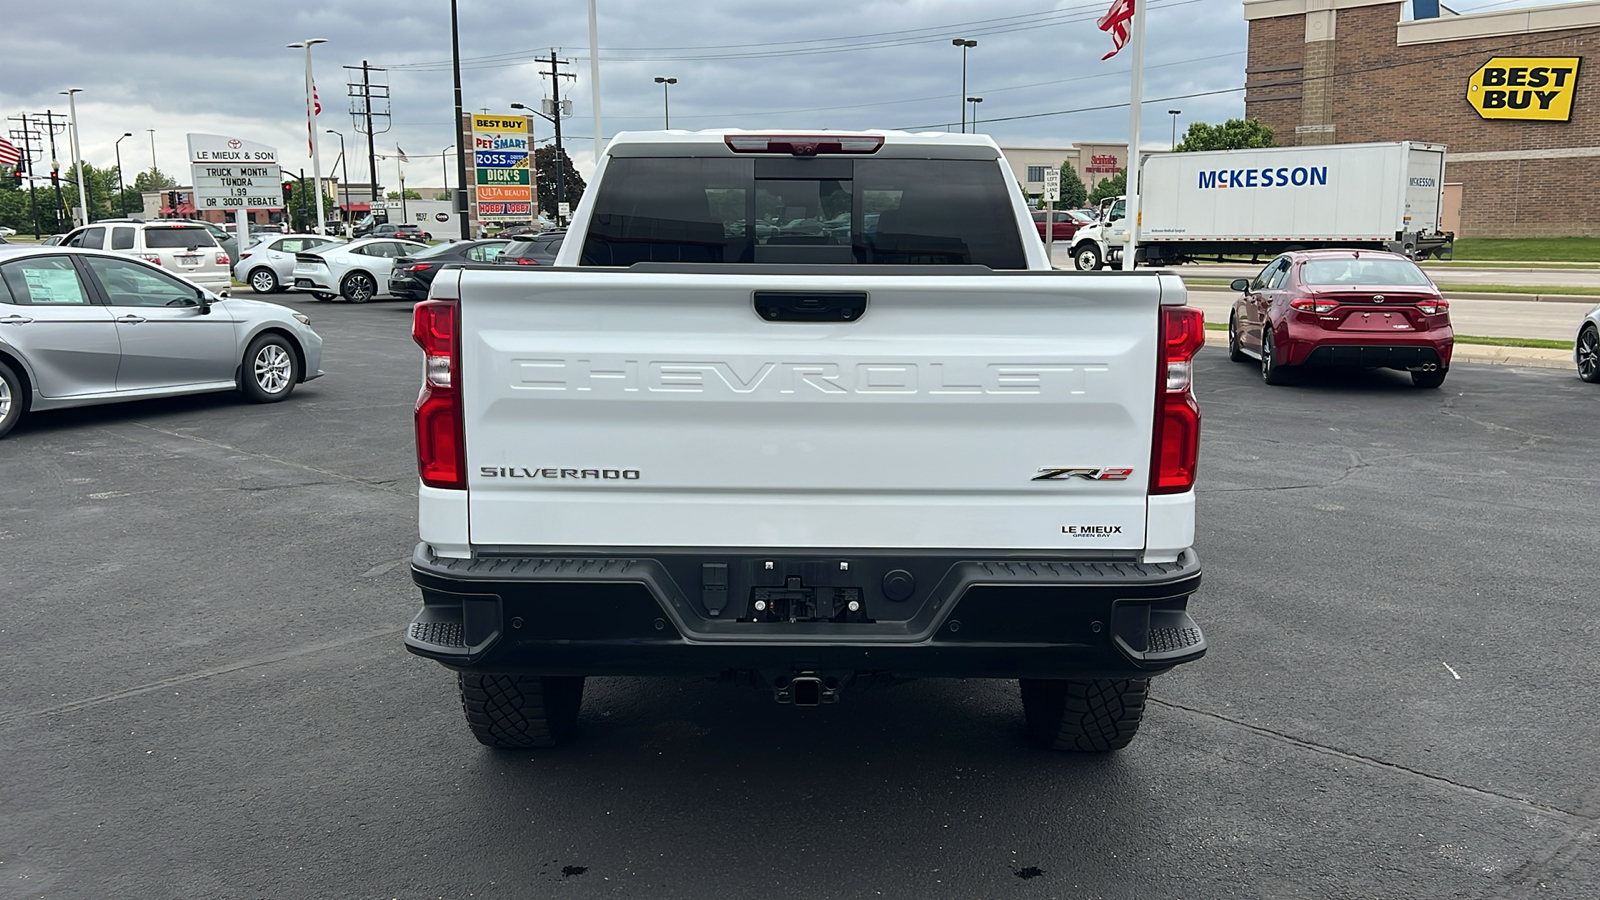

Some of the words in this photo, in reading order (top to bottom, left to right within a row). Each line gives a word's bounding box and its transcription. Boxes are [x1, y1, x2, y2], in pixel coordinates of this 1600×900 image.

[1482, 68, 1573, 88] BEST
[1482, 90, 1561, 110] BUY
[476, 119, 500, 128] BEST
[502, 120, 523, 129] BUY
[196, 151, 209, 160] LE
[212, 151, 241, 160] MIEUX
[244, 152, 251, 160] &
[254, 151, 274, 160] SON
[476, 154, 507, 165] ROSS
[206, 168, 232, 177] TRUCK
[240, 168, 268, 176] MONTH
[487, 169, 520, 181] DICK'S
[220, 178, 253, 187] TUNDRA
[230, 188, 247, 197] 1.99
[480, 187, 503, 197] ULTA
[504, 189, 529, 197] BEAUTY
[206, 198, 217, 207] OR
[223, 198, 243, 206] 3000
[247, 197, 277, 206] REBATE
[479, 203, 505, 213] HOBBY
[506, 203, 531, 214] LOBBY
[510, 358, 1109, 395] CHEVROLET
[480, 467, 641, 480] SILVERADO
[1030, 467, 1134, 481] ZR2
[1061, 526, 1077, 534] LE
[1080, 526, 1122, 534] MIEUX
